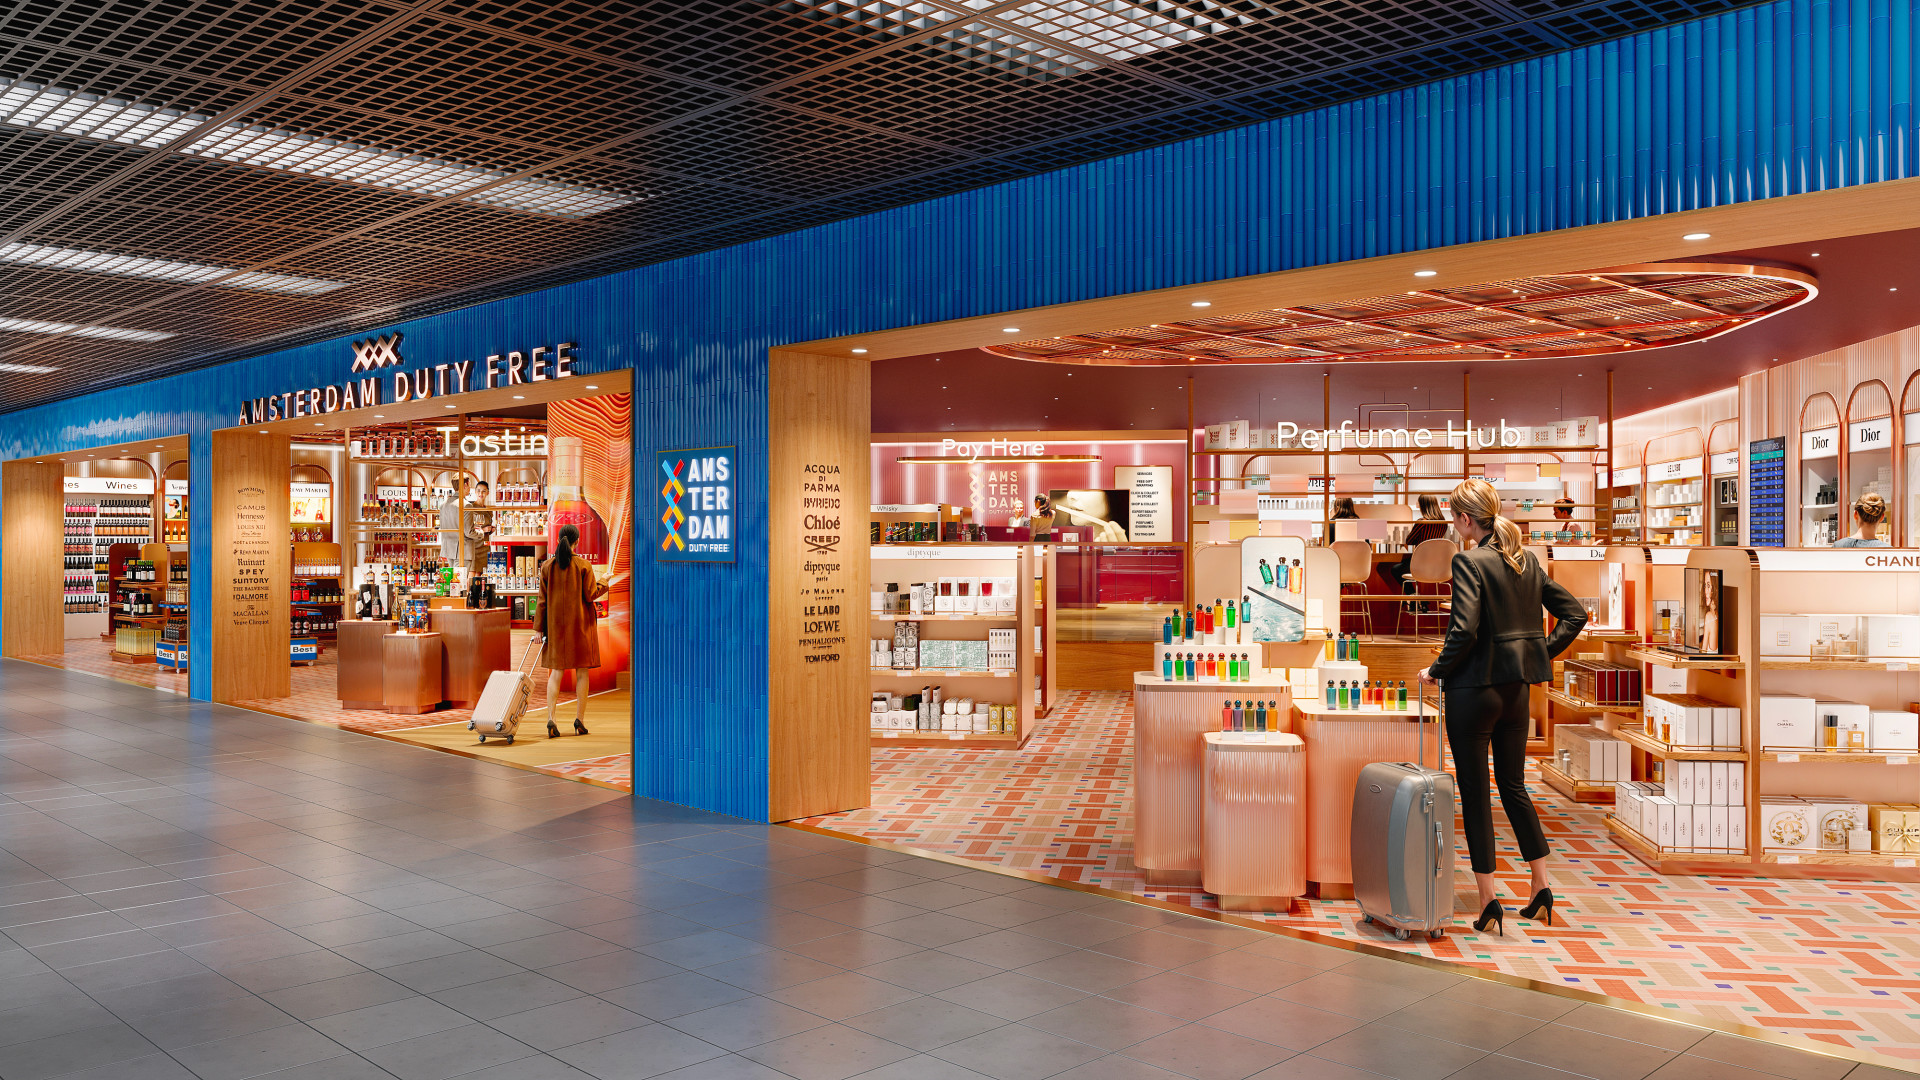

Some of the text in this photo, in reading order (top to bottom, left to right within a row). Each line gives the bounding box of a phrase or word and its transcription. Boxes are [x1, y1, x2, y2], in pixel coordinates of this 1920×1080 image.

[238, 342, 573, 425] AMSTERDAM DUTY FREE
[1277, 418, 1521, 449] Perfume Hub
[1860, 428, 1881, 443] Dior
[436, 426, 548, 456] Tastin
[1811, 436, 1829, 450] Dior
[942, 438, 1045, 464] Pay Here
[687, 456, 729, 482] AMS
[804, 464, 840, 474] ACQUA
[988, 471, 1018, 482] AMS
[105, 481, 138, 489] Wines
[804, 483, 840, 493] PARMA
[988, 484, 1018, 495] TER
[382, 489, 406, 497] LOUIS
[687, 486, 729, 511] TER
[804, 497, 840, 509] BYREDO
[237, 512, 265, 520] Hennessy
[688, 515, 729, 539] DAM
[803, 514, 840, 530] Chloé
[803, 535, 840, 549] CREED
[688, 544, 730, 553] DUTY FREE
[907, 548, 941, 558] diptyque
[1590, 549, 1605, 558] Dio
[237, 558, 265, 566] Ruinart
[804, 560, 840, 575] diptyque
[804, 605, 840, 616] LE LABO
[804, 620, 840, 633] LOEWE
[798, 637, 845, 646] PENHALIGON'S
[804, 654, 840, 663] TOM FORD
